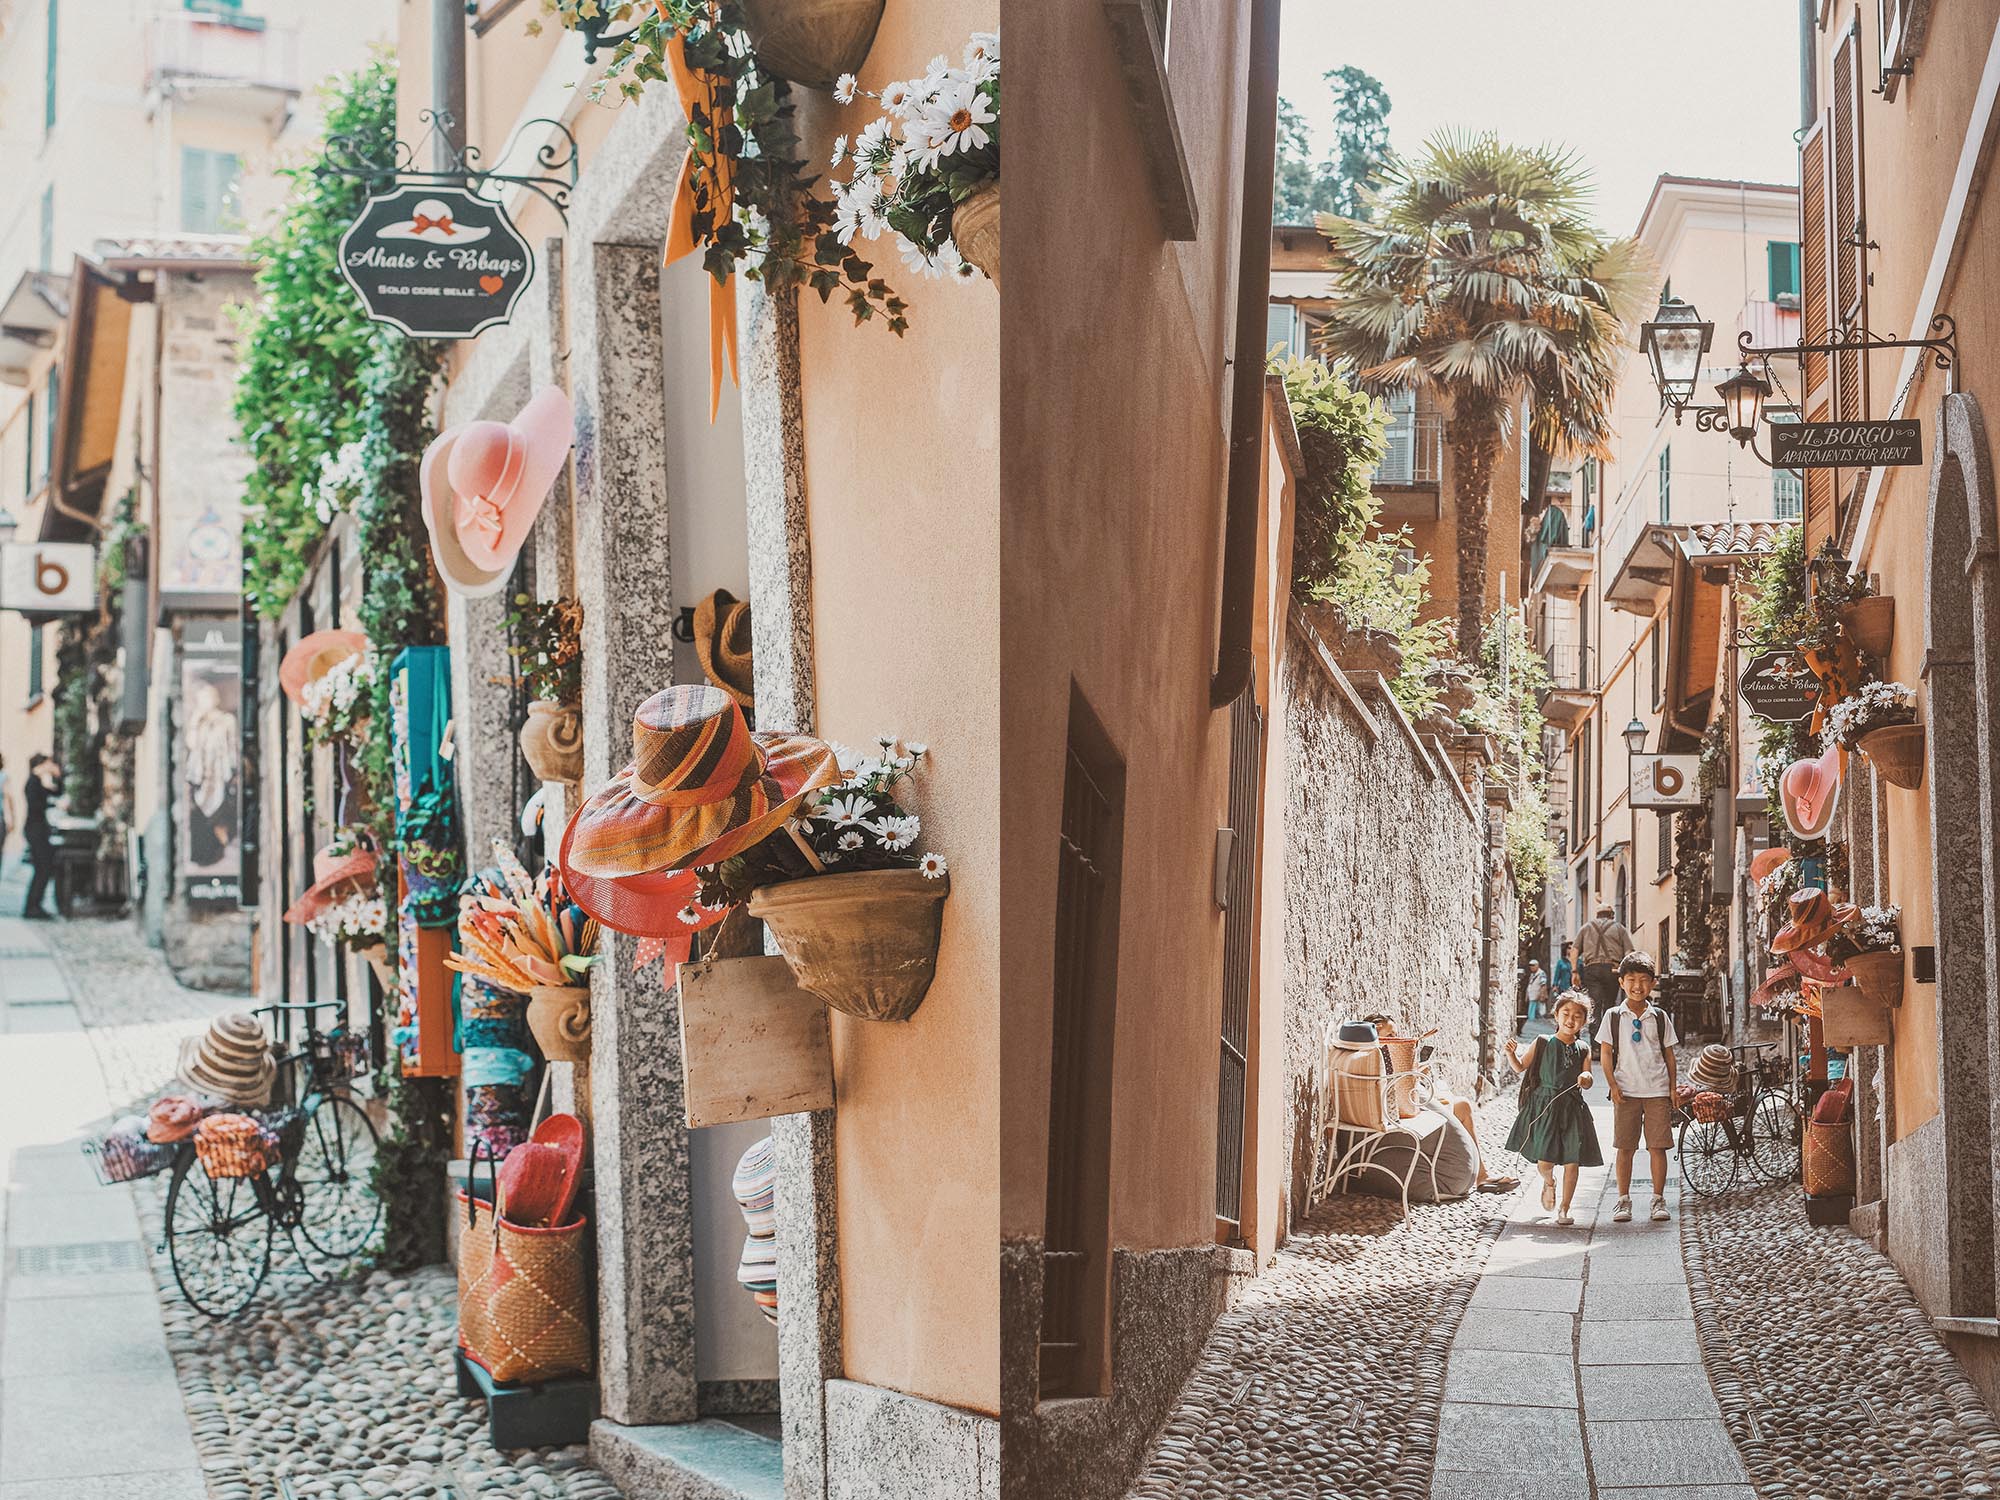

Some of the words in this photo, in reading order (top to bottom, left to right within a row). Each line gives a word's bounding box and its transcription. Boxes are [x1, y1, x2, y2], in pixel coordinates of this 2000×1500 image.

[347, 246, 419, 270] Ahats
[423, 250, 445, 270] &
[449, 248, 524, 278] Bbags
[1797, 428, 1823, 448] IL
[1823, 426, 1895, 448] BORGO
[1777, 448, 1853, 464] APARTMENTS
[1853, 447, 1878, 464] FOR
[1879, 446, 1912, 462] RENT
[1742, 680, 1777, 692] Ahats
[1778, 680, 1788, 690] &
[1790, 679, 1820, 692] Bbag
[1653, 757, 1684, 796] b
